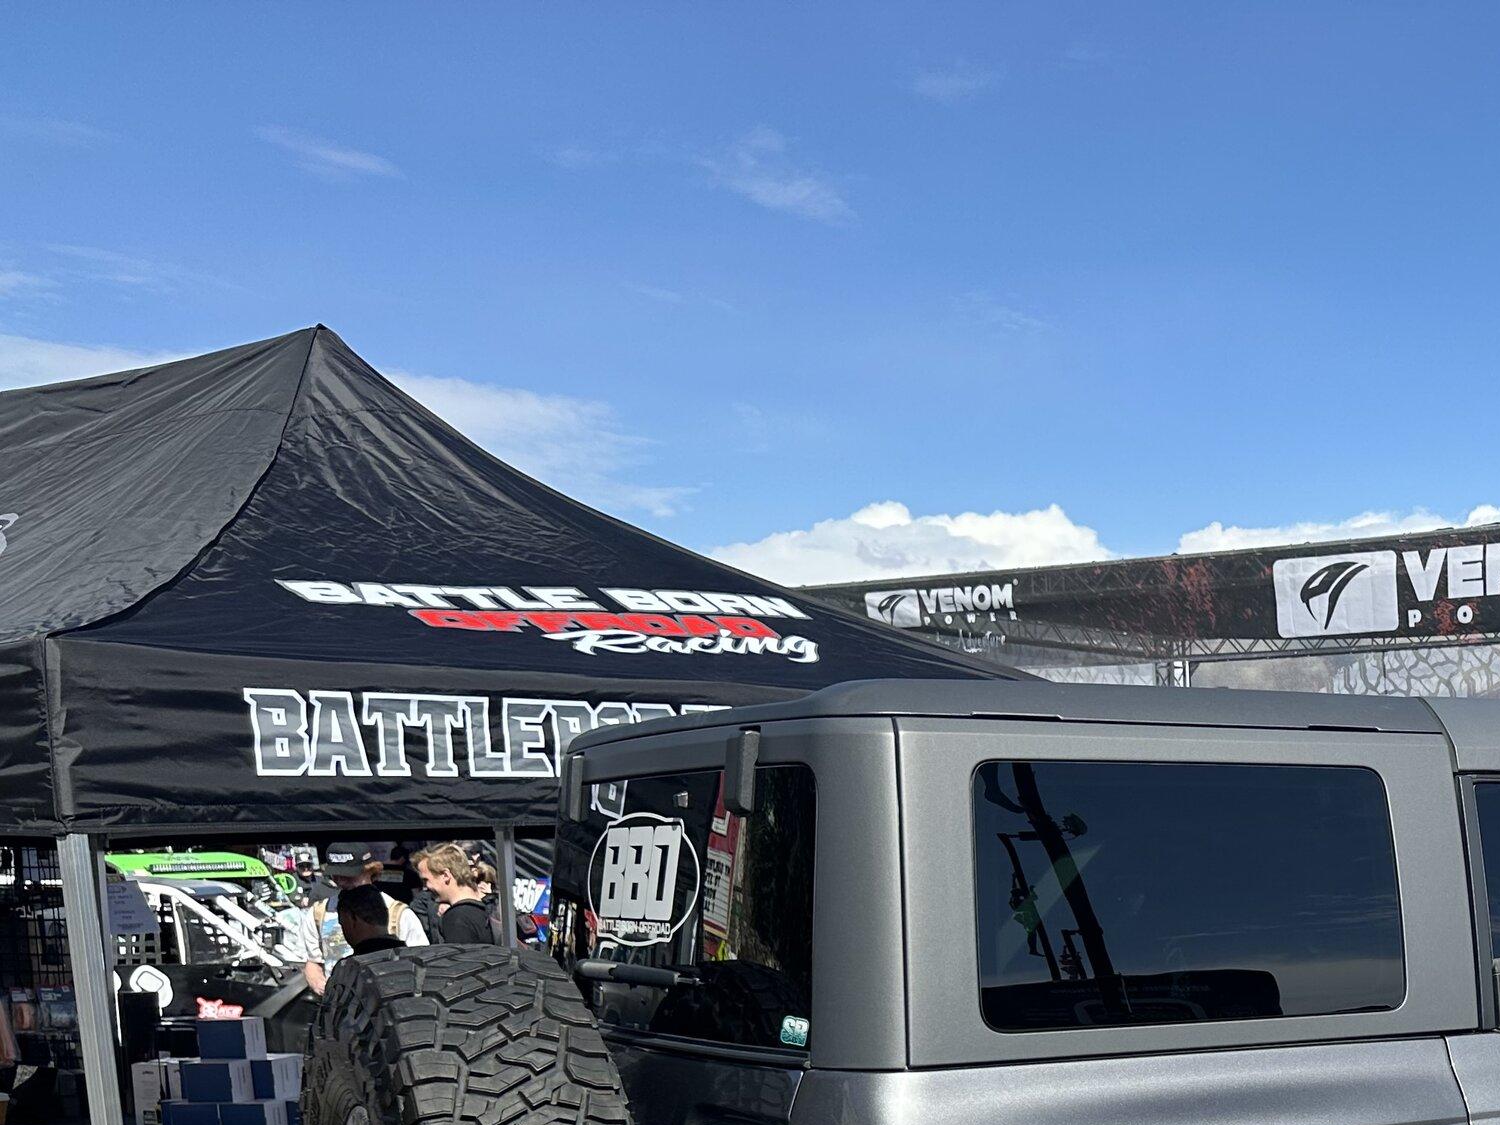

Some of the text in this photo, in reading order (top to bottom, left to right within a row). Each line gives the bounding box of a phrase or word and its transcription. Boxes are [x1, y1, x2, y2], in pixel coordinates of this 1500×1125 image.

[274, 579, 813, 620] BATTLE BORN
[918, 584, 1014, 614] VENOM
[408, 609, 782, 638] OFFROAD
[541, 629, 820, 663] Racing
